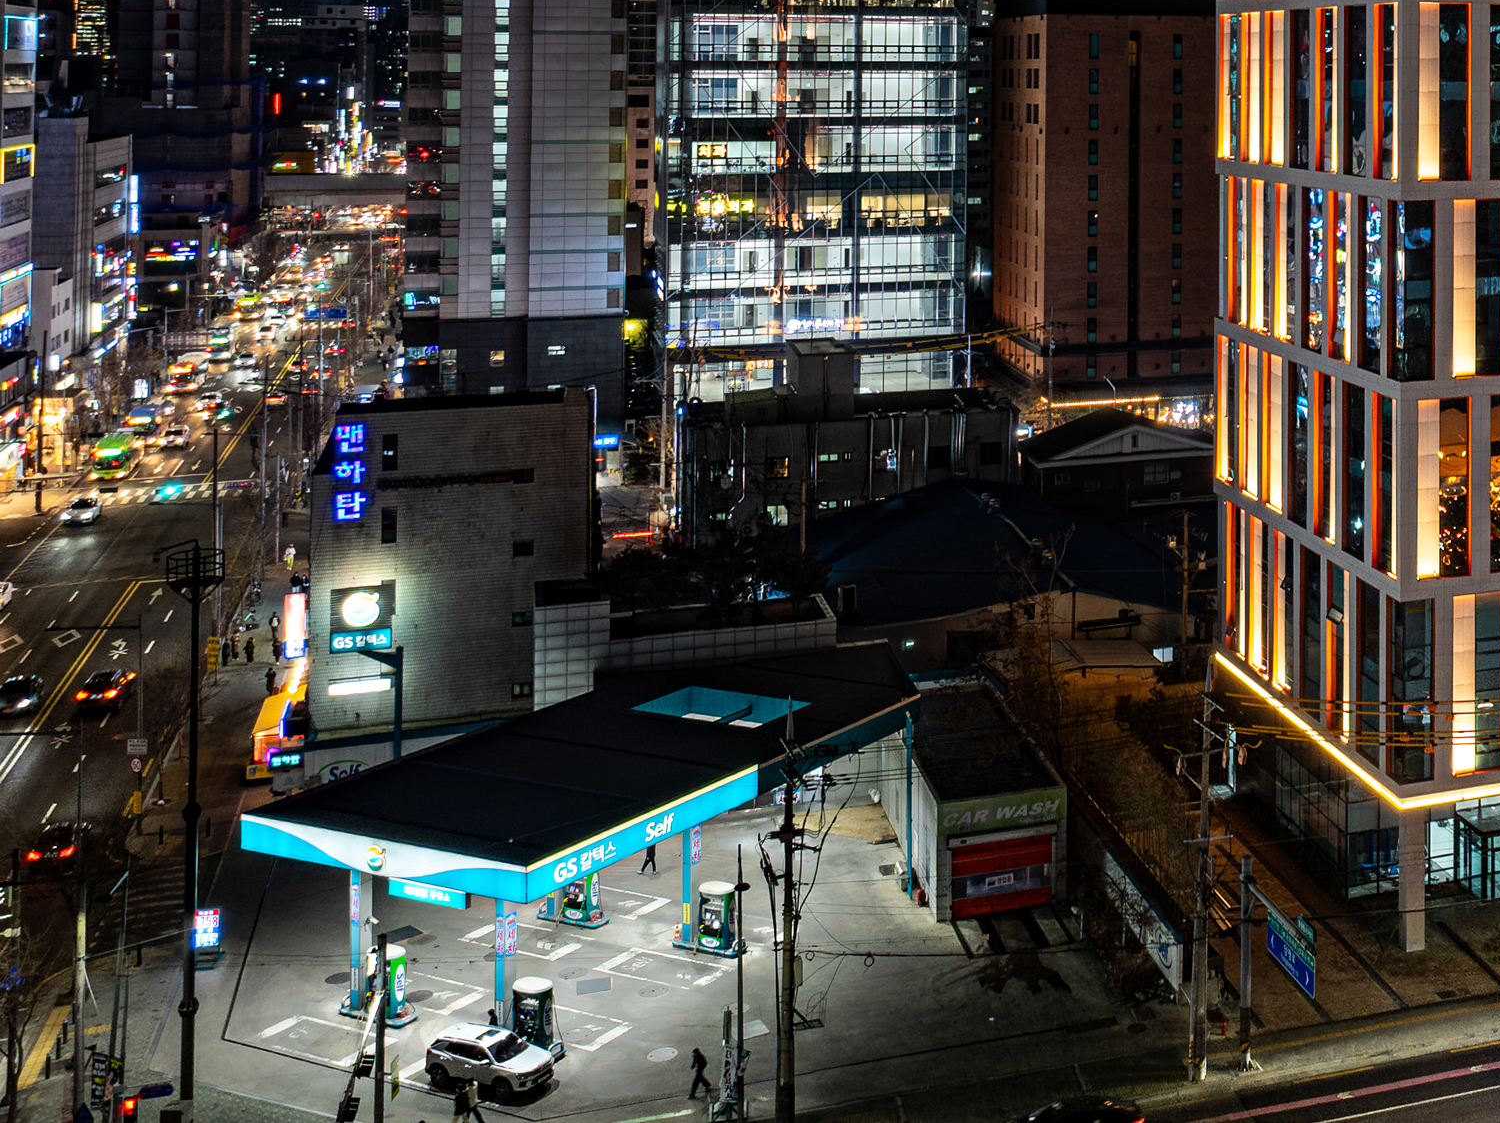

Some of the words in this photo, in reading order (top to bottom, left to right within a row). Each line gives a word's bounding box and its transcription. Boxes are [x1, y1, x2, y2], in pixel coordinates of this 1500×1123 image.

[698, 144, 727, 158] 치과
[334, 423, 367, 521] 맨하탄
[333, 636, 354, 649] GS
[355, 633, 388, 647] 칼텍스
[132, 760, 140, 771] 50
[942, 809, 989, 828] CAR
[995, 798, 1061, 820] WASH
[553, 857, 579, 883] GS
[580, 840, 617, 872] 칼텍스
[644, 812, 675, 842] Self
[506, 927, 516, 956] 세차
[396, 973, 405, 993] Self
